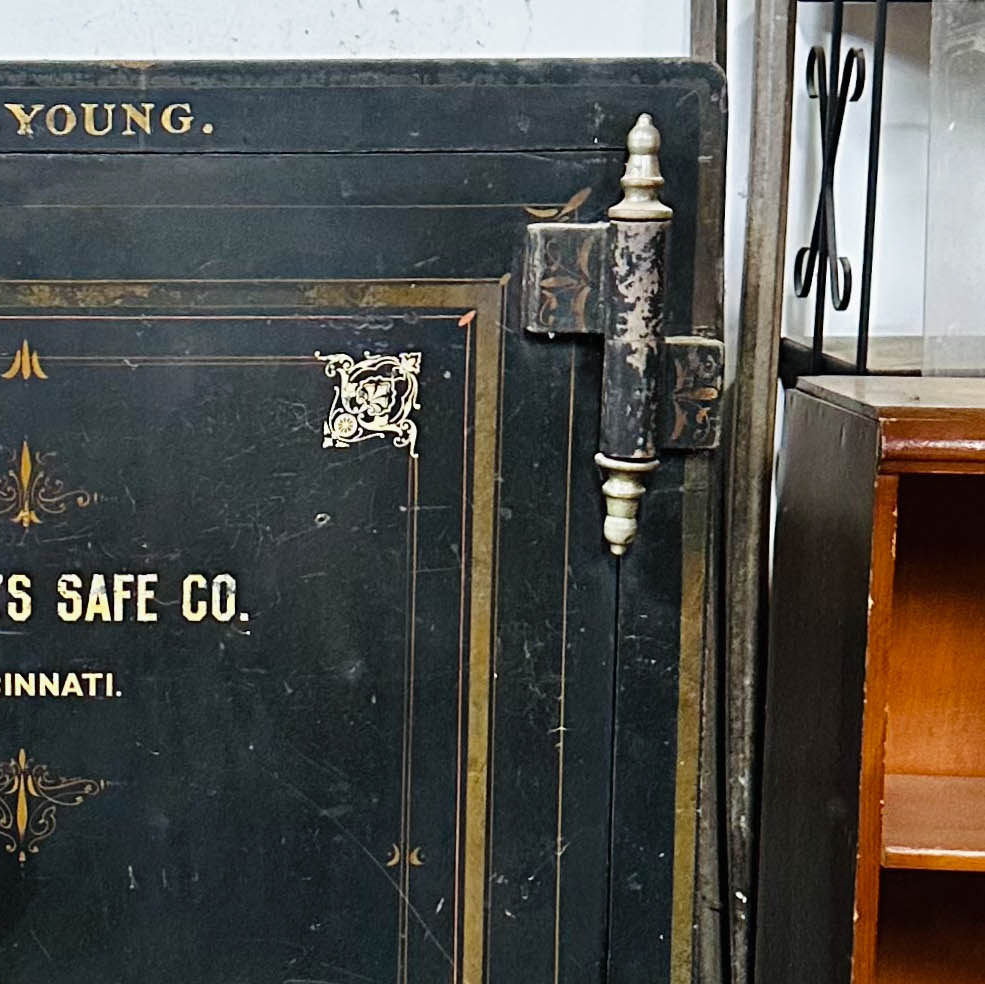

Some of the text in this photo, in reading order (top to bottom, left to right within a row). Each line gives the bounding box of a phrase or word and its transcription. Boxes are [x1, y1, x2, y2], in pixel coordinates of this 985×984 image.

[5, 103, 214, 136] YOUNG.
[57, 573, 158, 622] SAFE
[181, 573, 249, 622] CO.
